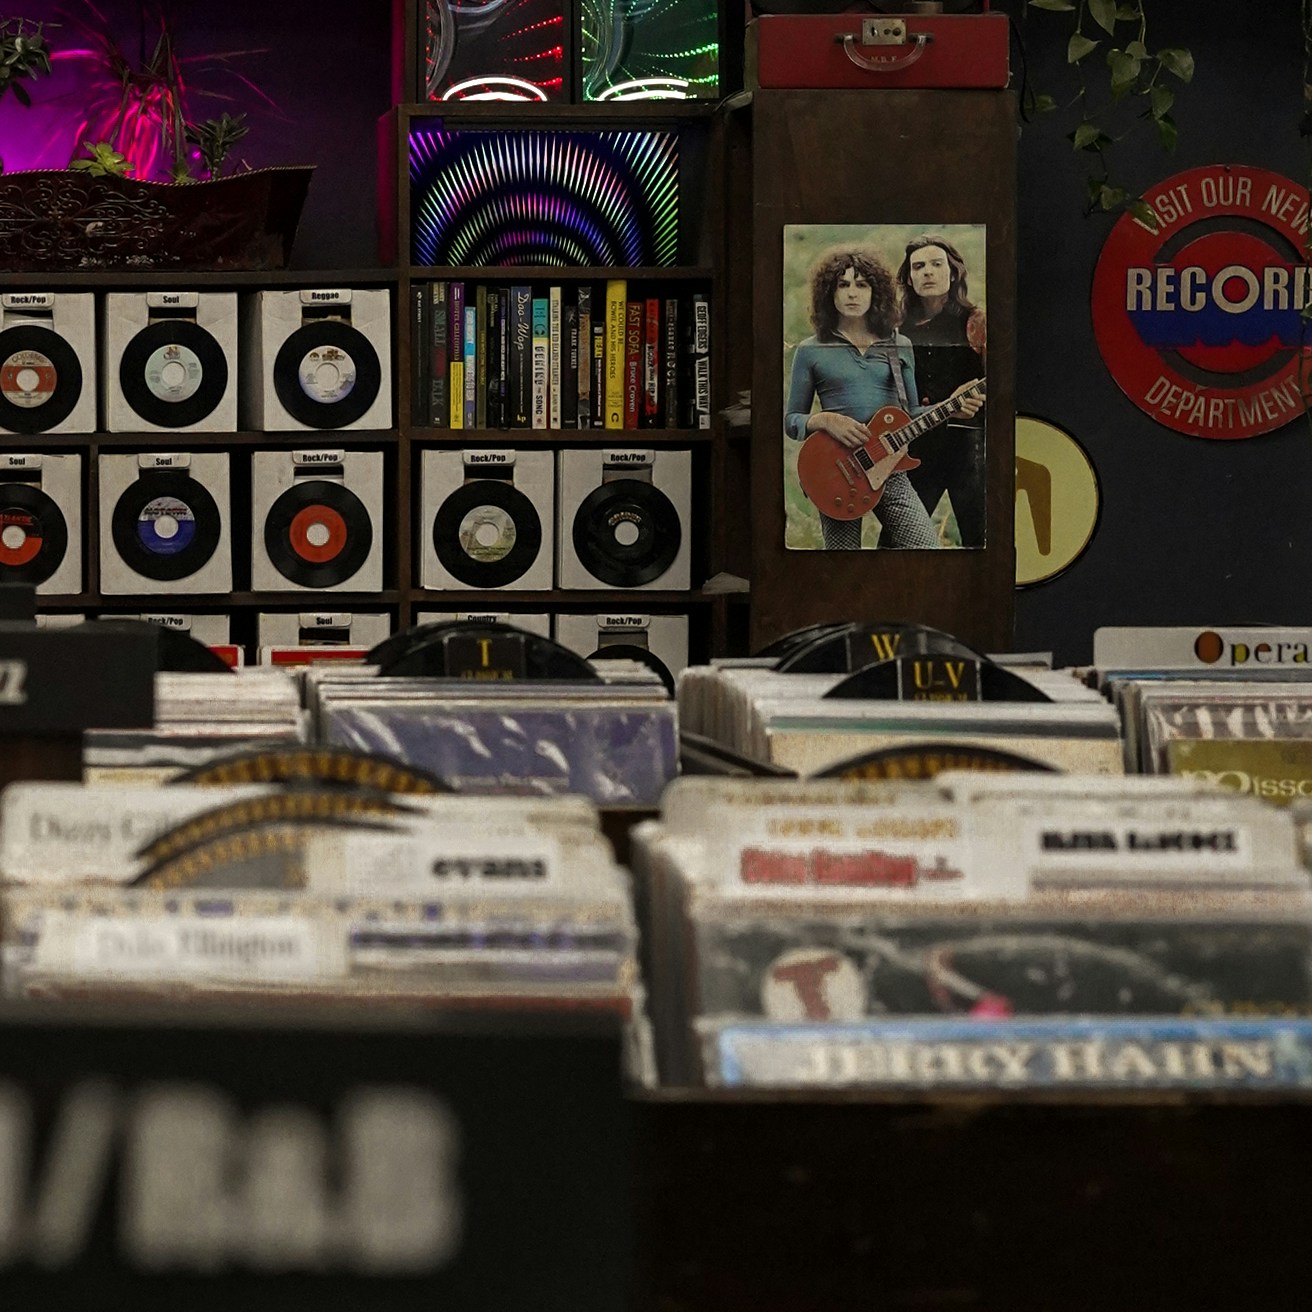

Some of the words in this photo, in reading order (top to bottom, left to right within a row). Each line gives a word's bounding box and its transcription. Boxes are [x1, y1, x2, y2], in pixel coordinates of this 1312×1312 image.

[1200, 176, 1252, 208] OUR
[10, 295, 47, 305] Rock/Pop
[162, 295, 180, 304] Soul
[311, 291, 340, 301] Reggae
[513, 291, 530, 351] Doo-Wop
[628, 305, 640, 327] FAST
[697, 305, 707, 324] GEOFF
[628, 329, 640, 355] SOFA
[697, 325, 707, 349] EDGERS
[629, 361, 637, 384] Bruce
[697, 361, 708, 379] WALK
[698, 379, 708, 394] THIS
[535, 395, 543, 415] SONG
[698, 395, 708, 409] WAY
[1144, 375, 1304, 429] DEPARTMENT
[8, 457, 26, 465] Soul
[155, 457, 173, 466] Soul
[302, 453, 338, 463] Rock/Pop
[470, 453, 506, 462] Rock/Pop
[610, 453, 646, 462] Rock/Pop
[315, 616, 333, 625] Soul
[467, 614, 497, 624] Country
[606, 616, 642, 626] Rock/Pop
[871, 633, 901, 661] W
[1194, 630, 1312, 667] Opera
[913, 661, 965, 689] U-V
[431, 854, 549, 882] evans
